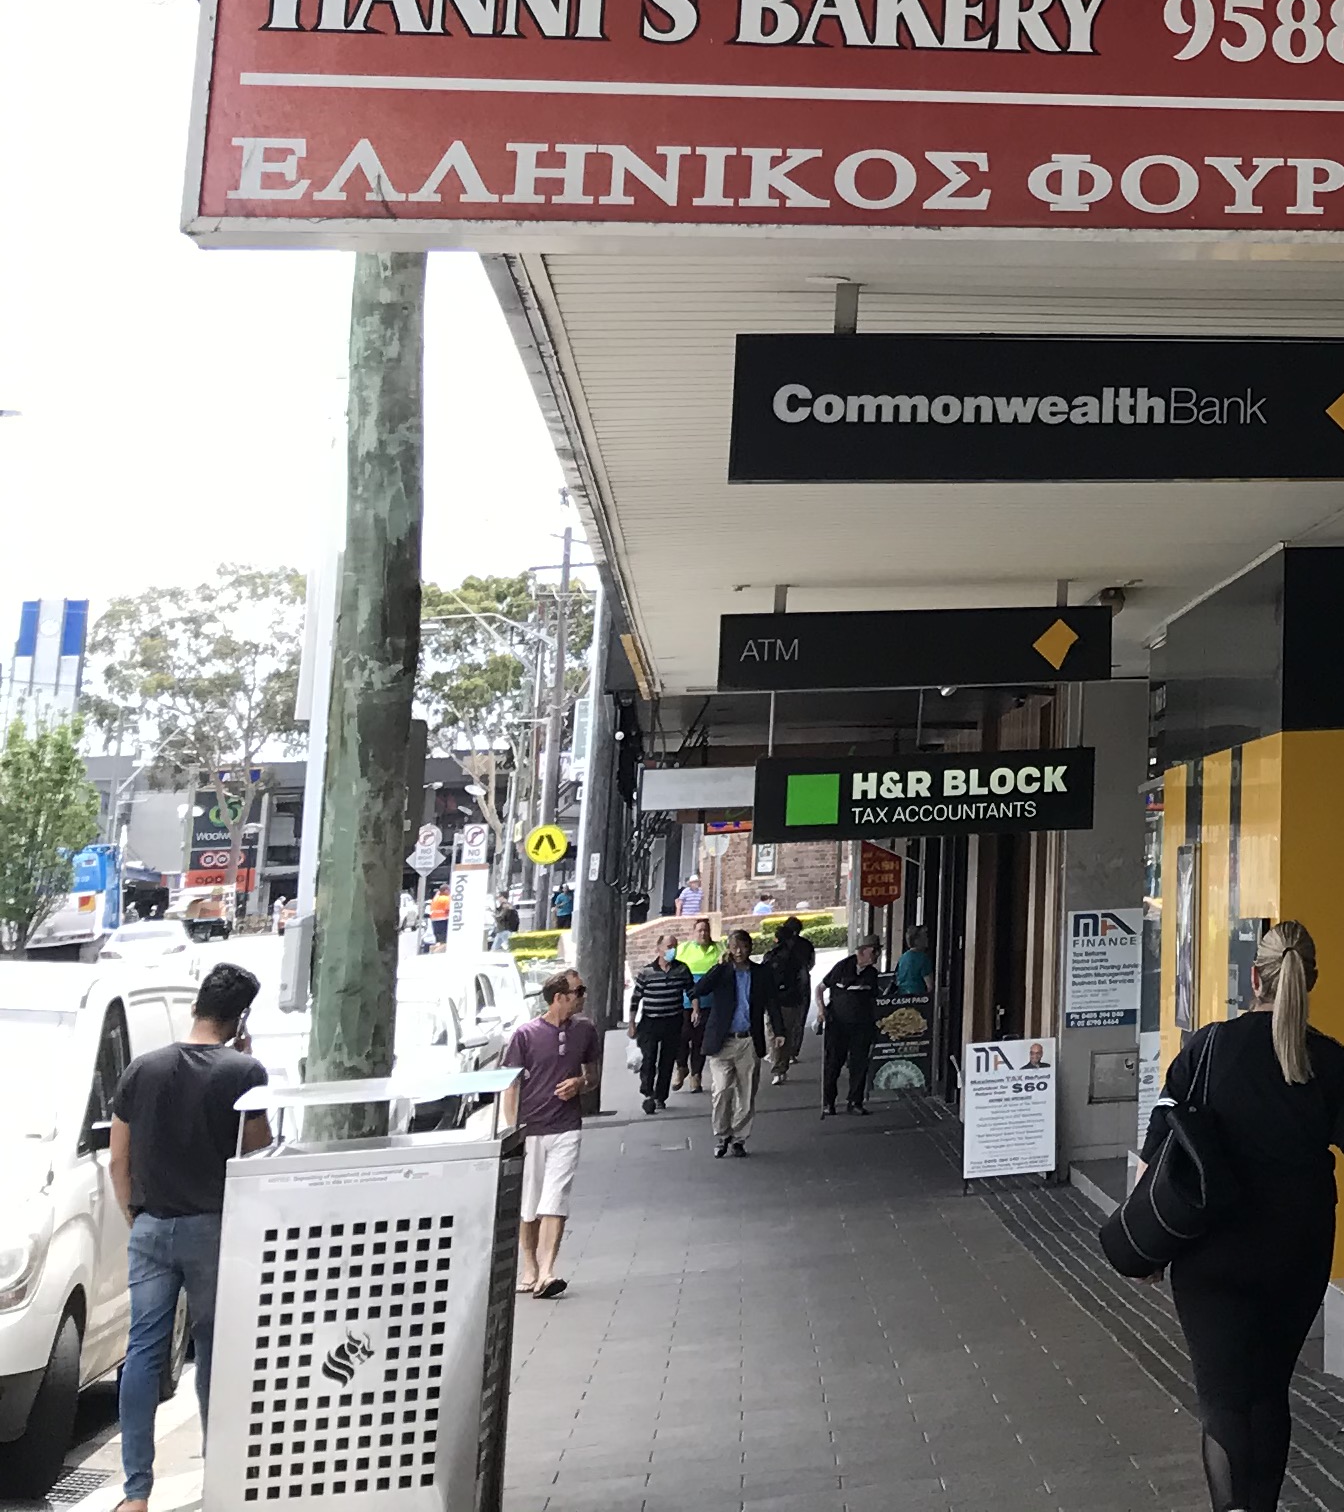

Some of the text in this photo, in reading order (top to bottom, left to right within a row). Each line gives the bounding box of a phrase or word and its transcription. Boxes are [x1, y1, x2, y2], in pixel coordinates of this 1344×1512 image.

[226, 137, 991, 210] ΕΛΛΗΝΙΚΟΣ
[739, 638, 799, 662] ATM
[851, 764, 1068, 800] H&R BLOCK
[851, 800, 1036, 824] TAX ACCOUNTANTS
[862, 860, 900, 870] CASH
[867, 873, 894, 883] FOR
[862, 885, 898, 896] GOLD
[452, 874, 468, 932] Kogarah
[1073, 937, 1137, 948] FINANCE
[911, 996, 929, 1004] PAID
[1012, 1081, 1048, 1094] $60
